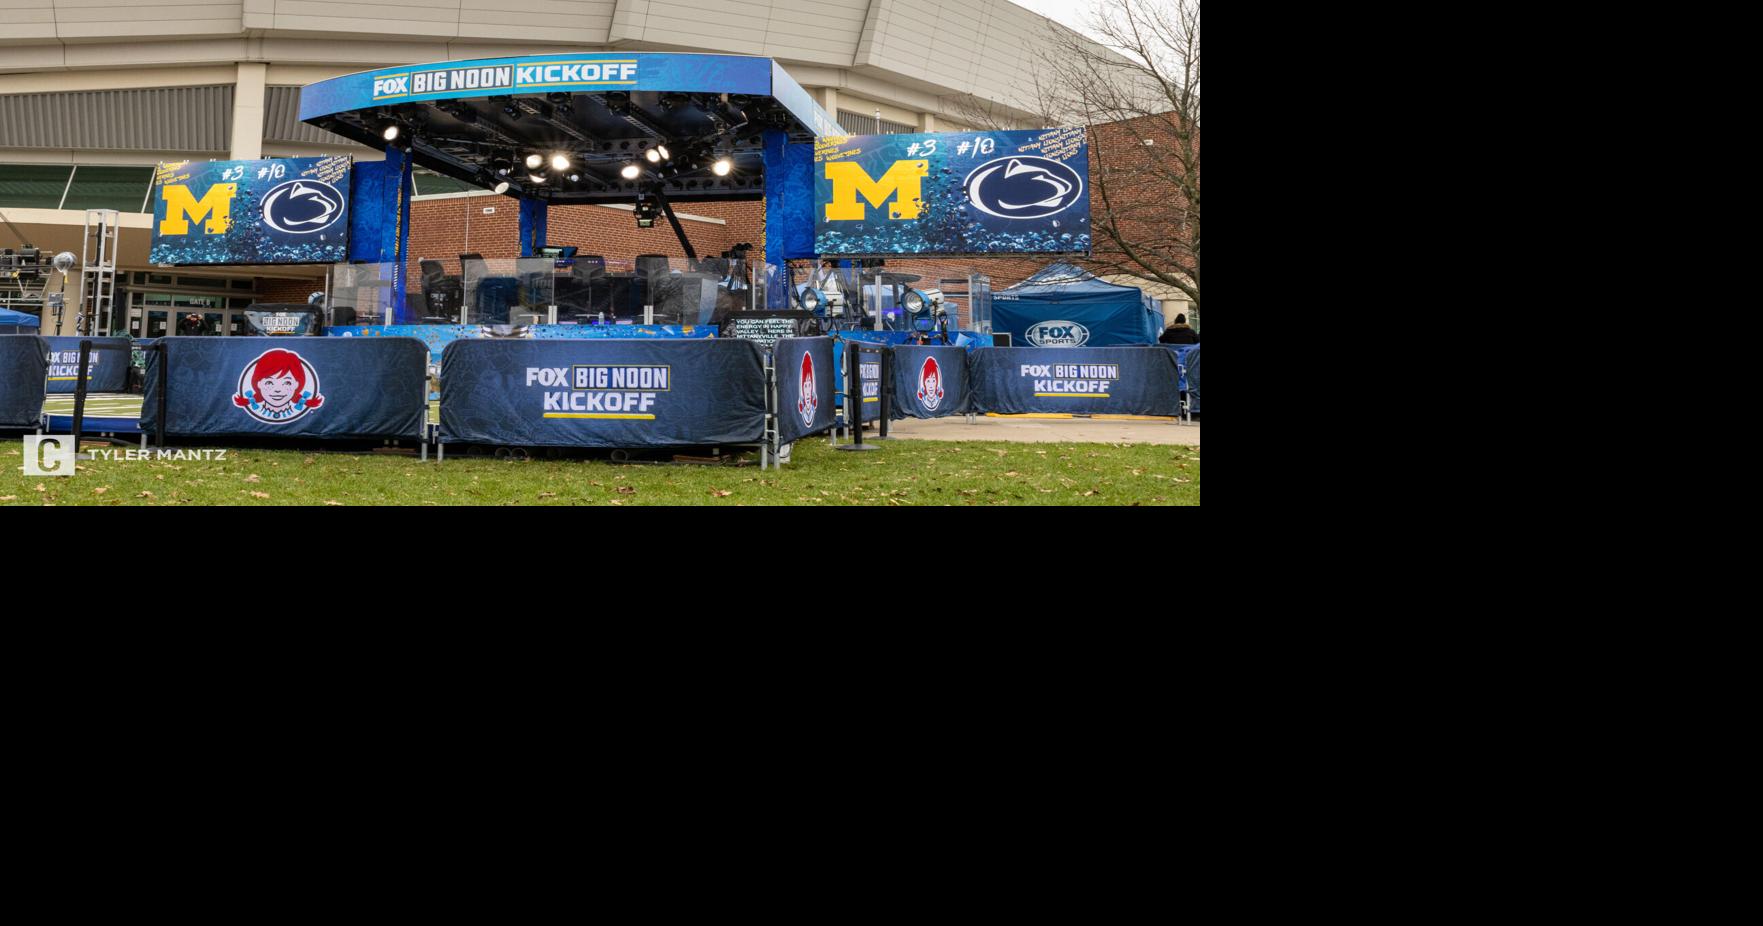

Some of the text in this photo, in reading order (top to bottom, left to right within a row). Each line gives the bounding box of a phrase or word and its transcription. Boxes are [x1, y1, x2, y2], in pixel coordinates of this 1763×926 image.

[373, 63, 638, 96] FOX BIG NOON KICKOFF
[906, 139, 937, 157] #3
[222, 165, 244, 181] #3
[824, 159, 929, 221] M
[160, 182, 237, 236] M
[1039, 326, 1074, 339] FOX
[62, 352, 76, 364] BIG
[48, 365, 94, 377] KICKOF
[526, 367, 667, 389] FOX BIG NOON
[1020, 364, 1117, 379] FOX BIG NOON
[1034, 379, 1110, 393] KICKOFF
[543, 392, 656, 412] KICKOFF
